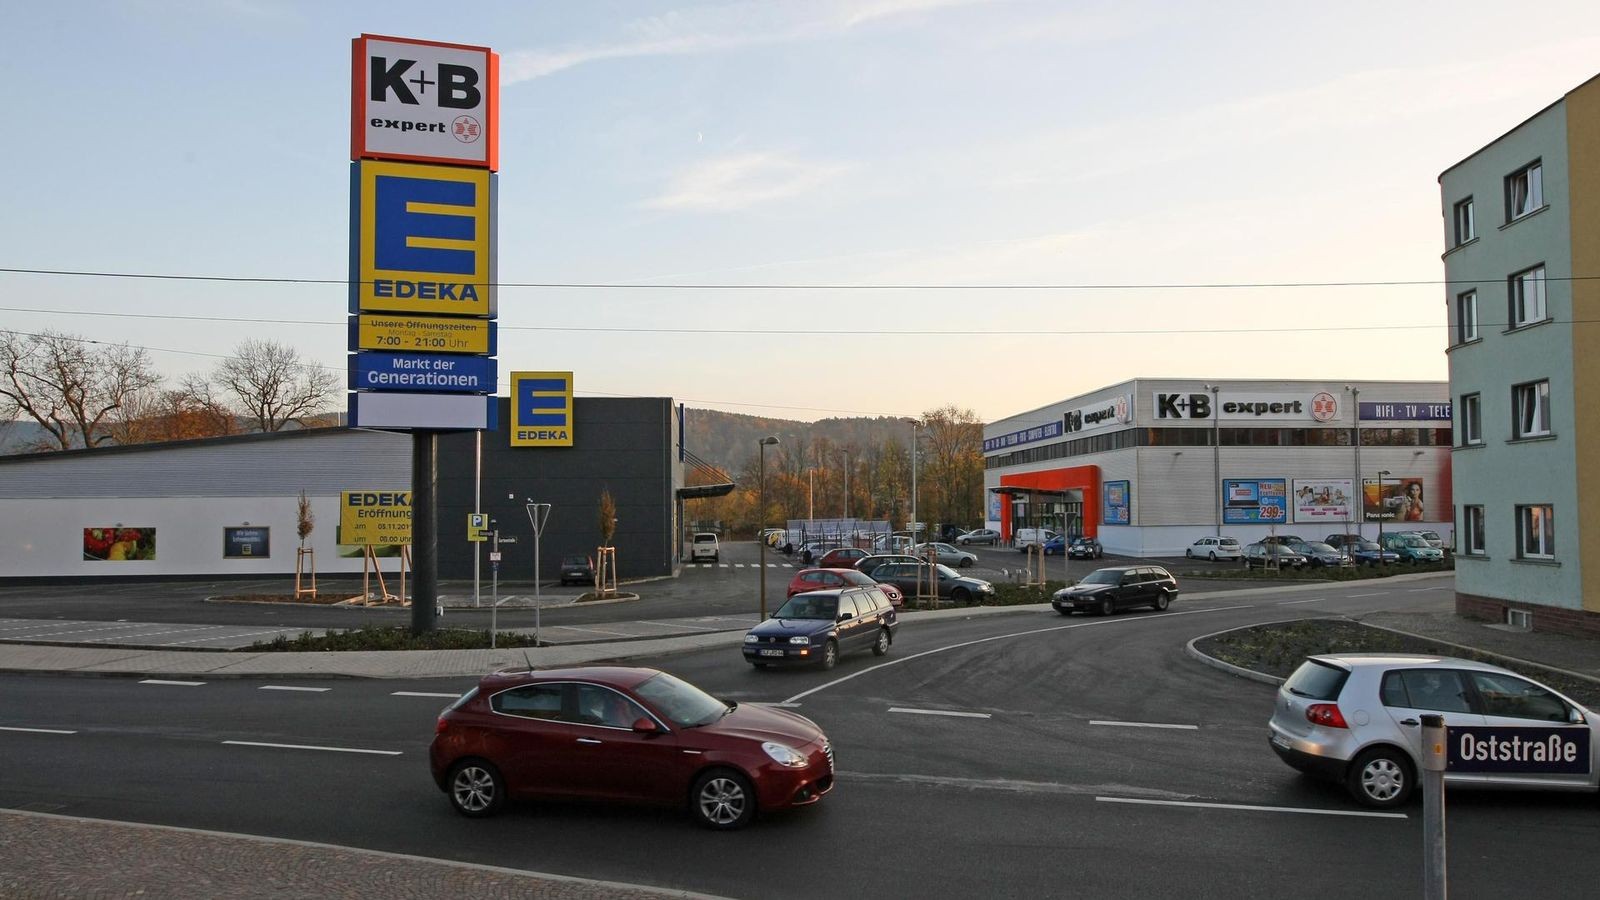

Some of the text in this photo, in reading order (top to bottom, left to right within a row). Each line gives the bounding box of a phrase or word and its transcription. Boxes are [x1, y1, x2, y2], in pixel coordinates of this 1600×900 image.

[371, 56, 481, 110] K+B
[371, 118, 446, 133] expert
[374, 279, 479, 301] EDEKA
[371, 320, 477, 332] Unsere Öffnungszeiten
[376, 336, 401, 345] 7:00
[415, 337, 446, 347] 21:00
[449, 339, 469, 348] Uhr
[393, 358, 455, 370] Markt der
[368, 370, 478, 386] Generationen
[1159, 394, 1302, 418] K+B expert
[1375, 405, 1394, 418] HIFI
[1406, 405, 1417, 418] TV
[1084, 405, 1115, 424] expert
[517, 430, 568, 440] EDEKA
[358, 508, 412, 520] Eröffnung
[473, 516, 482, 527] P
[1460, 733, 1577, 762] Oststraße
